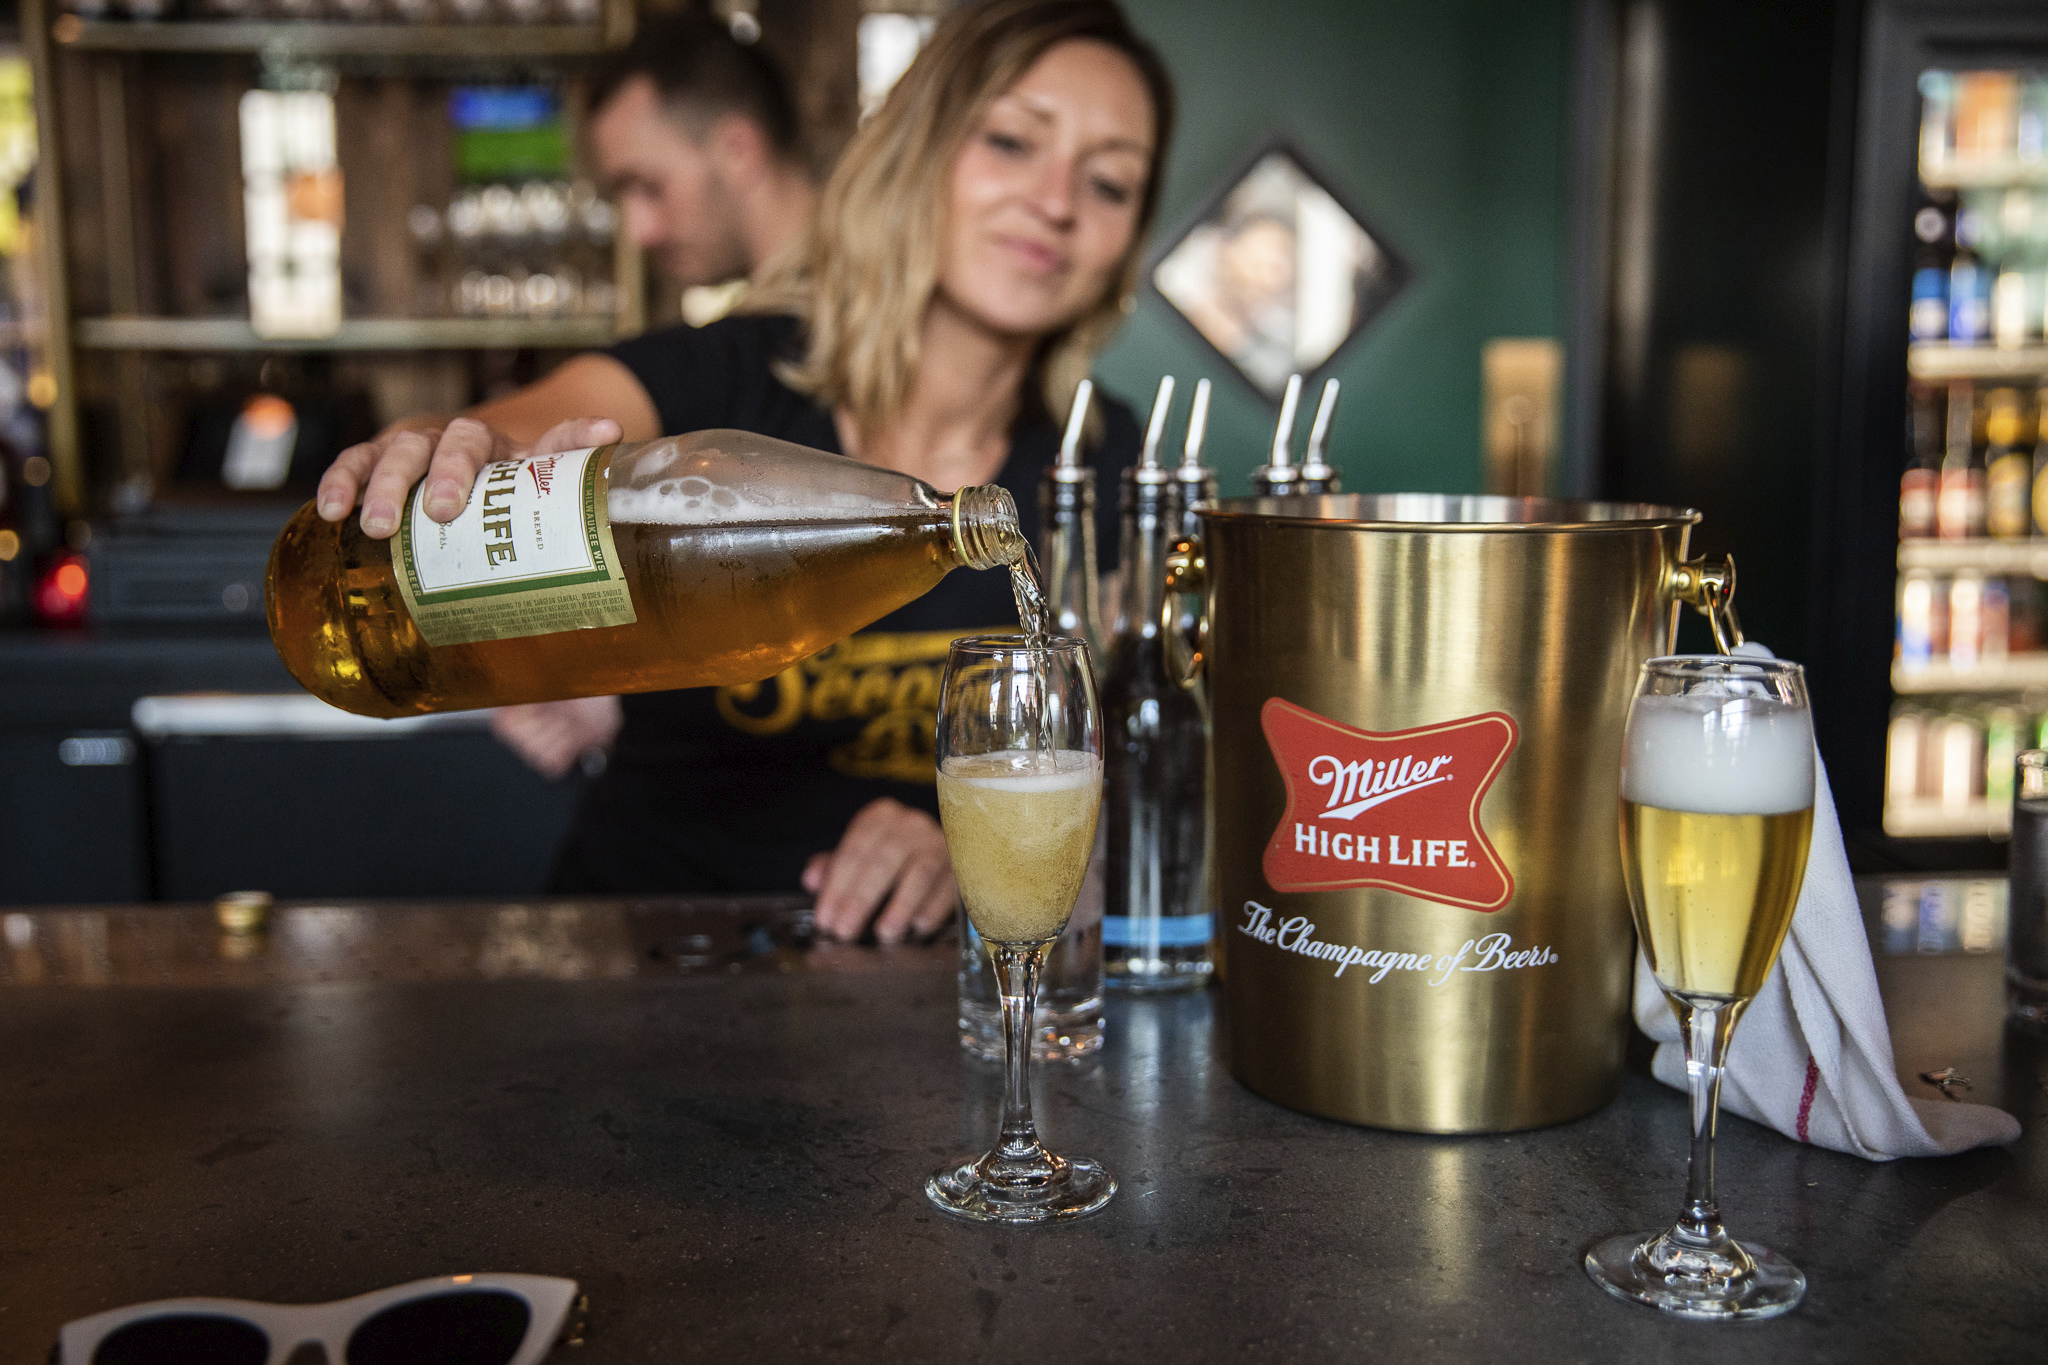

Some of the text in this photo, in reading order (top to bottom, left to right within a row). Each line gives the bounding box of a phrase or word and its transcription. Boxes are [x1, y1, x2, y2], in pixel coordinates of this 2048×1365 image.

[536, 454, 564, 496] Miller
[483, 486, 517, 566] LIFE
[533, 510, 544, 550] BREWED
[584, 489, 599, 547] MILWAUKEE
[593, 550, 606, 571] WIS
[407, 569, 421, 596] BEER
[602, 589, 622, 597] SHOULD
[1309, 754, 1453, 808] Miller
[1295, 823, 1470, 867] HIGH LIFE
[1237, 901, 1551, 987] The Champagne of Beers
